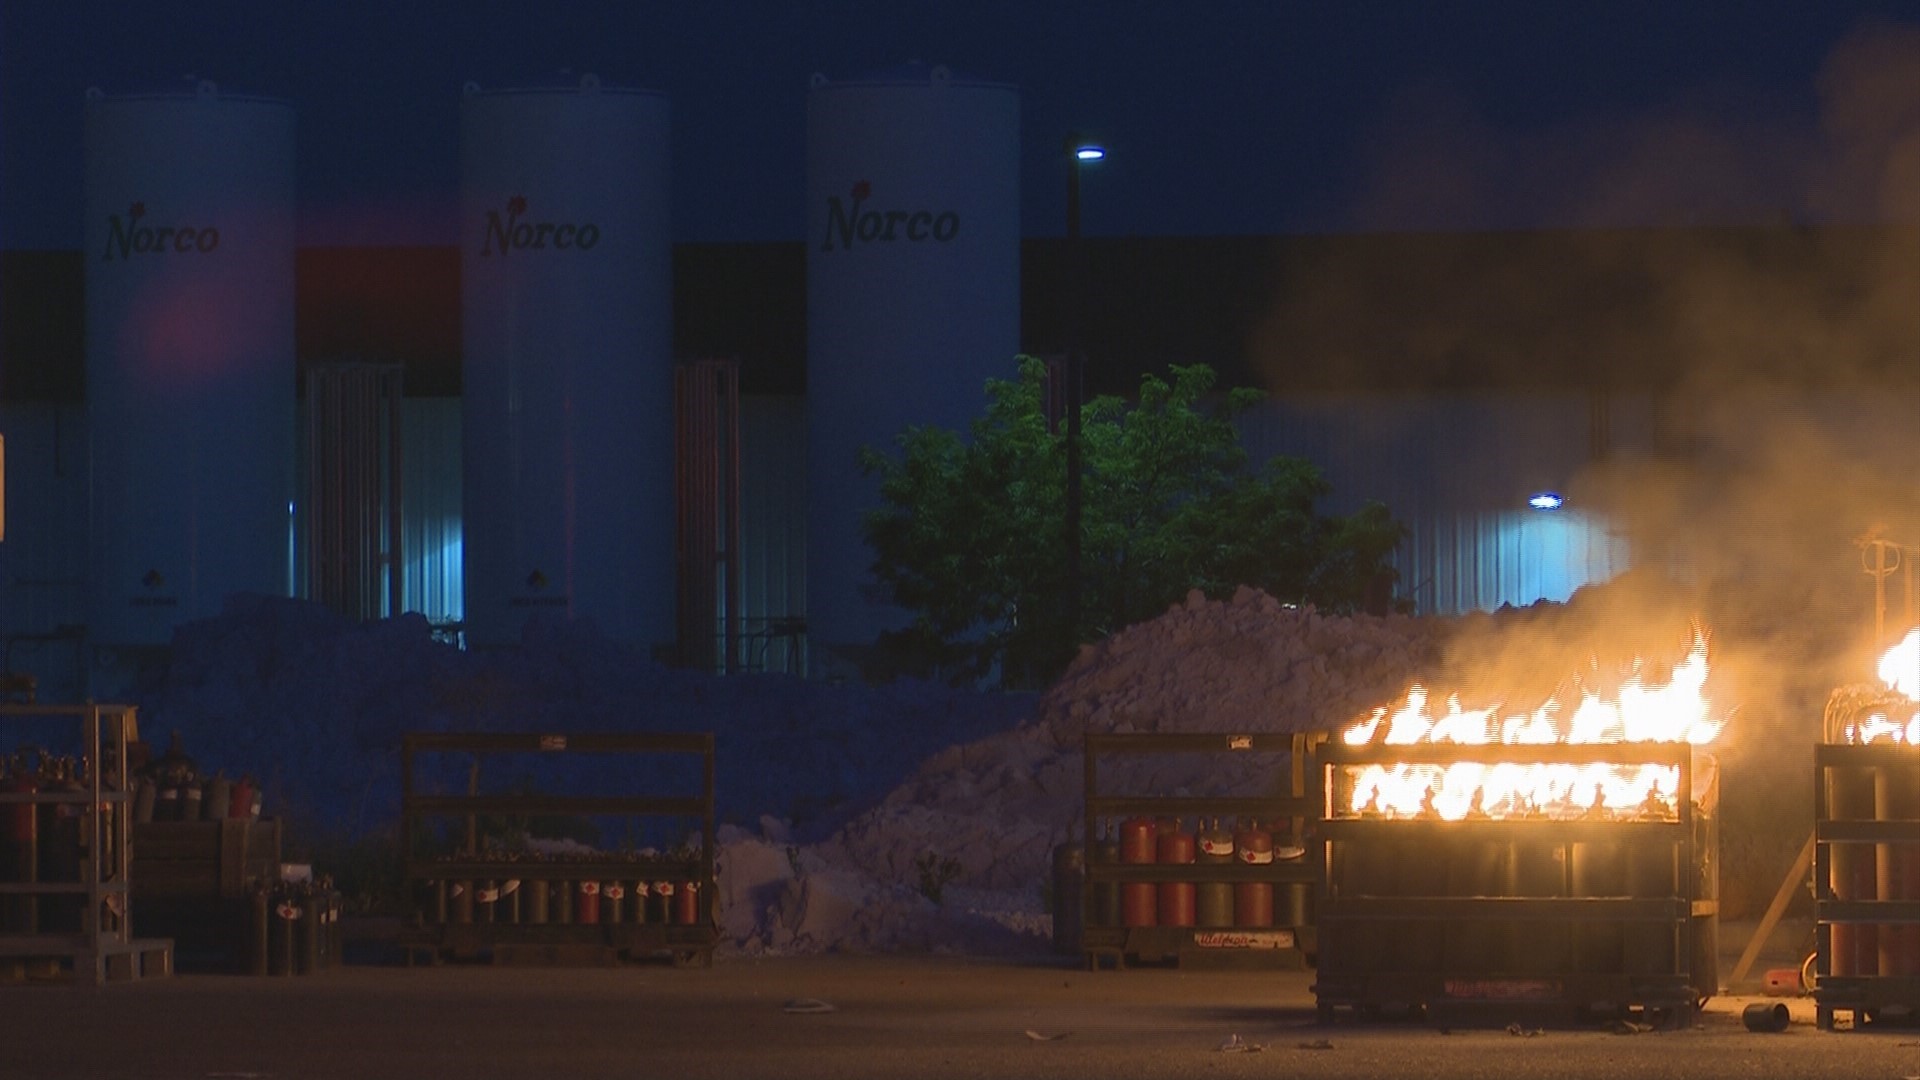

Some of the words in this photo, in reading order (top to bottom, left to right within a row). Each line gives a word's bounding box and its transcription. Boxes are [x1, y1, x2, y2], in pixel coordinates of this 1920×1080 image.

[102, 200, 220, 261] Norco
[480, 195, 600, 256] Norco
[821, 179, 961, 251] Norco
